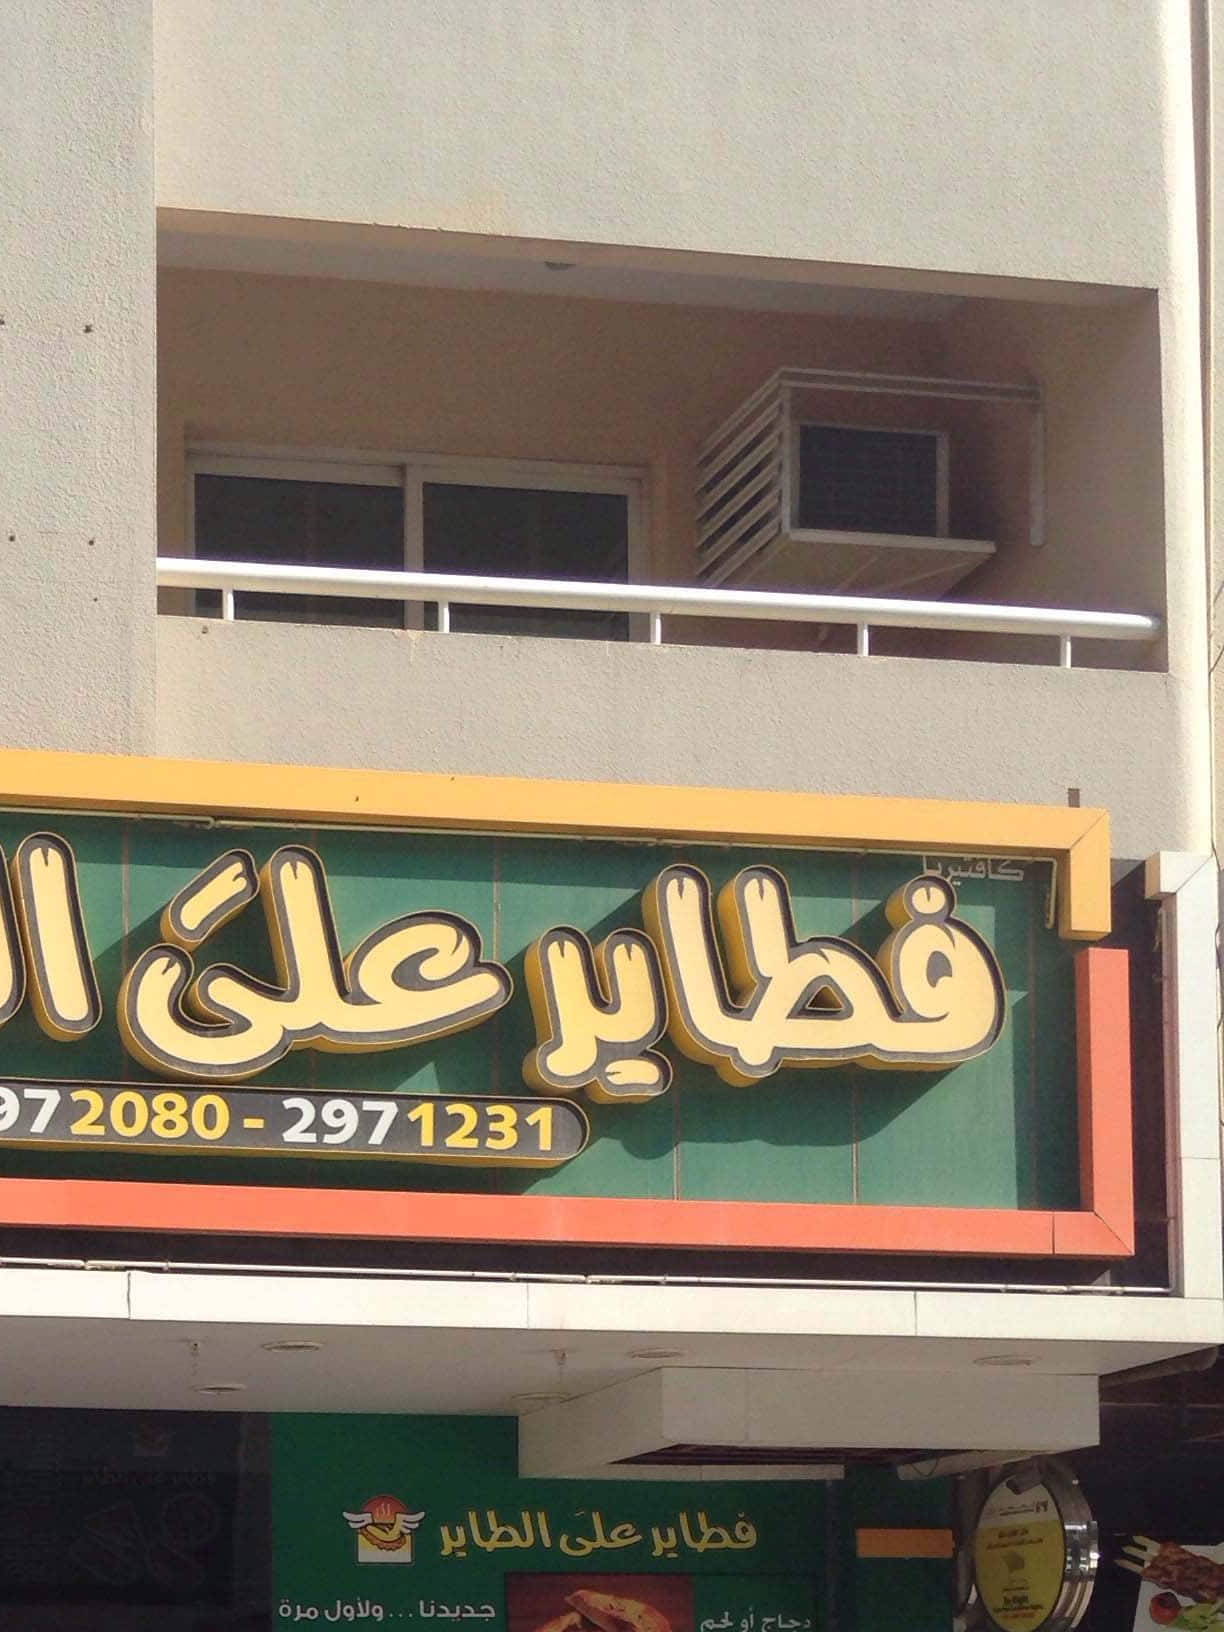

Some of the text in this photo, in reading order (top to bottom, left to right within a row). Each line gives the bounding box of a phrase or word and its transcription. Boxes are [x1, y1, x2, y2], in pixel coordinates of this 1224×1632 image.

[523, 864, 1006, 1104] فطاير
[440, 1510, 553, 1559] الطاير
[651, 1511, 759, 1559] فطاير
[278, 1599, 319, 1622] مرة
[419, 1599, 496, 1622] جديدنا
[700, 1611, 734, 1632] لحم
